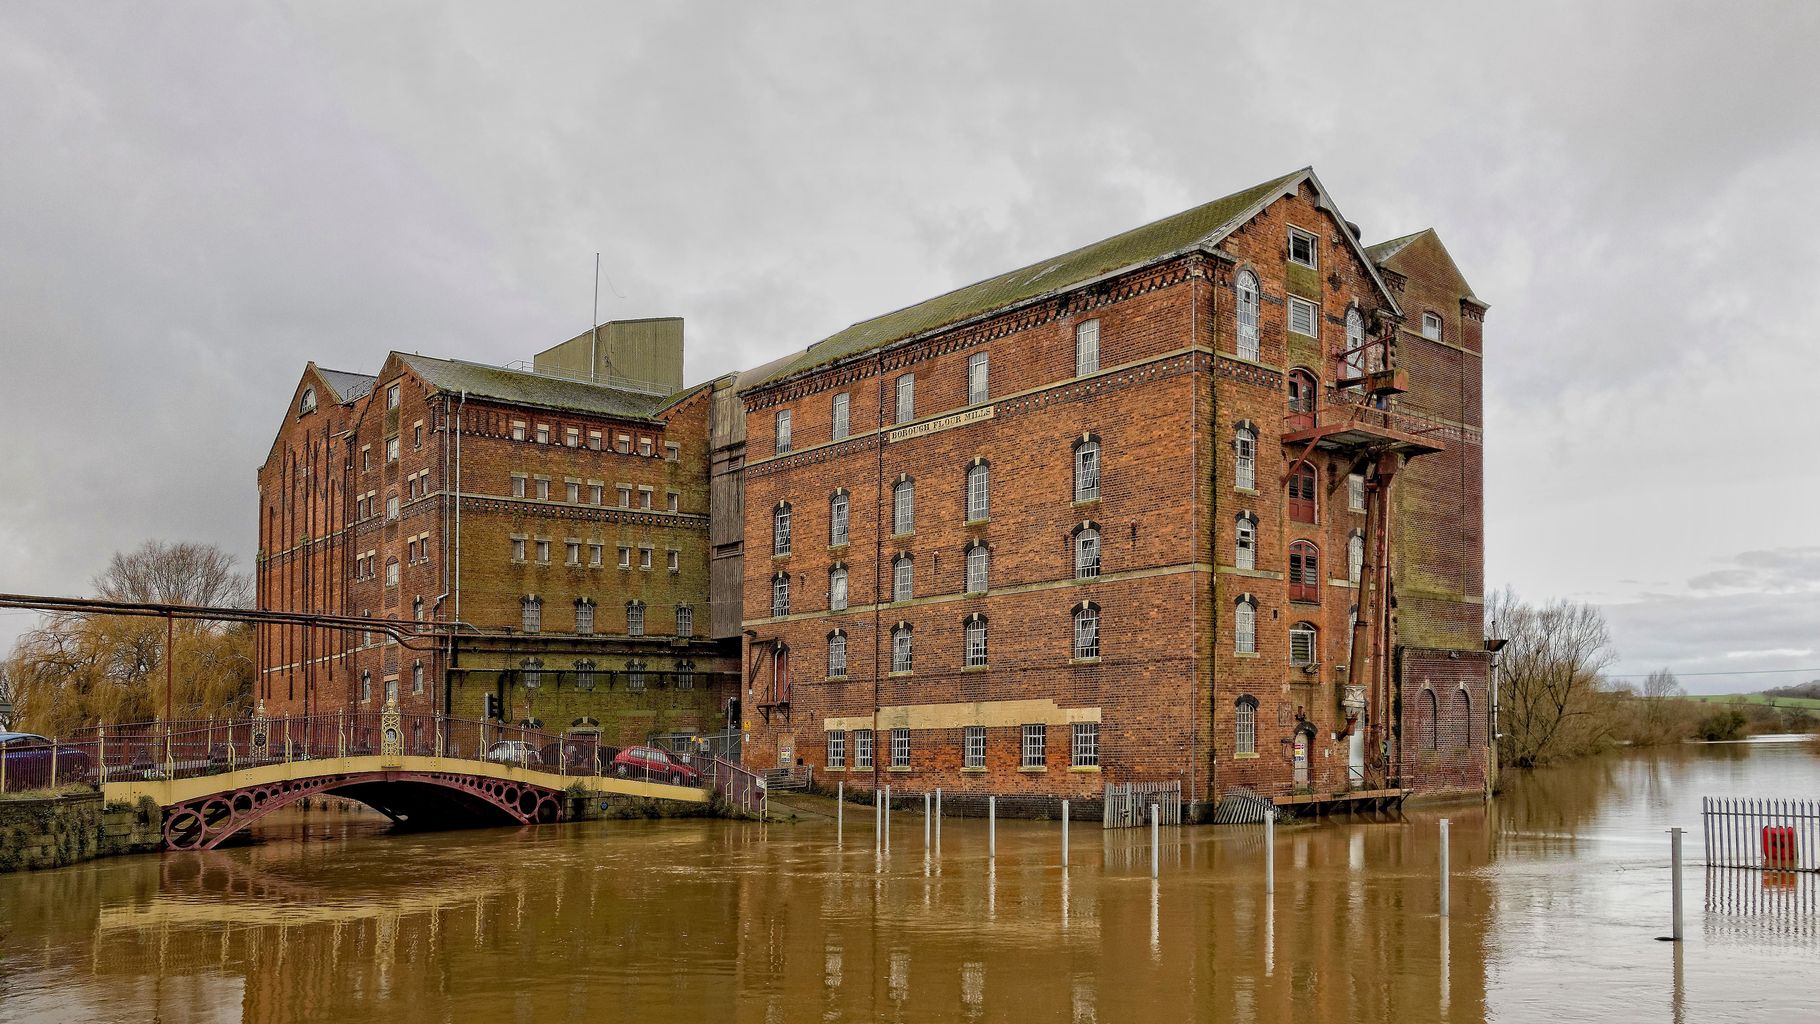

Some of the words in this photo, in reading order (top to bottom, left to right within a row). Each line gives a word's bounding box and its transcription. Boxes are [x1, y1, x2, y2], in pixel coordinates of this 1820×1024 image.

[891, 423, 930, 440] BOROUGH
[933, 416, 962, 429] FLOUR
[964, 408, 991, 421] MILLS
